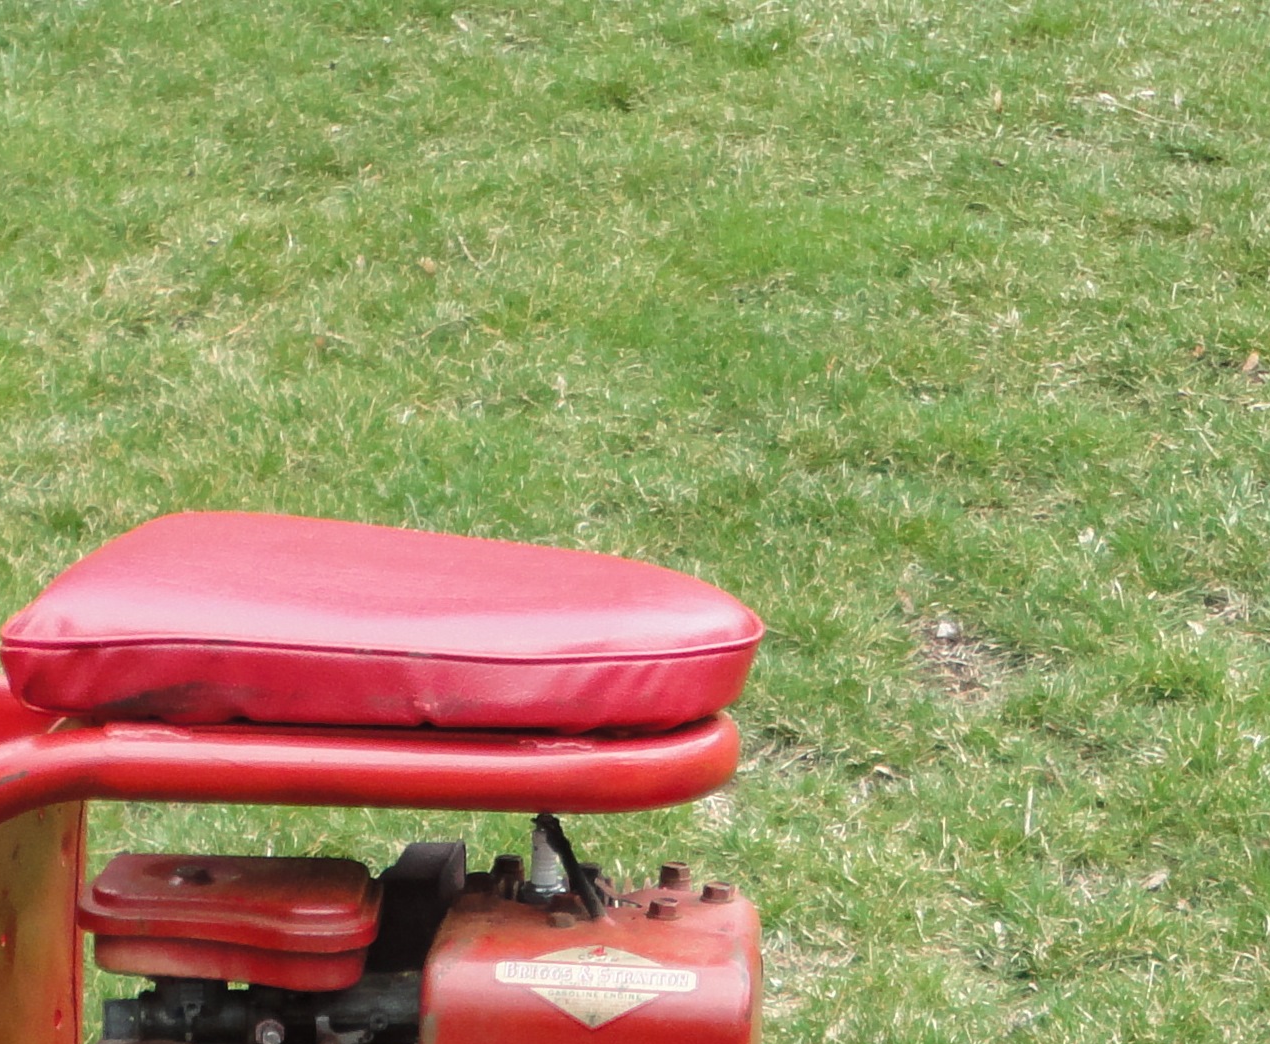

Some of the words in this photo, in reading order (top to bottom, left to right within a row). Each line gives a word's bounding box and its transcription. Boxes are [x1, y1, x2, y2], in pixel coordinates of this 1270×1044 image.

[504, 961, 572, 980] BRIGGS
[579, 966, 593, 982] &
[598, 968, 689, 987] STRATTON
[548, 989, 598, 999] GASOLINE
[604, 992, 643, 1001] ENGINE
